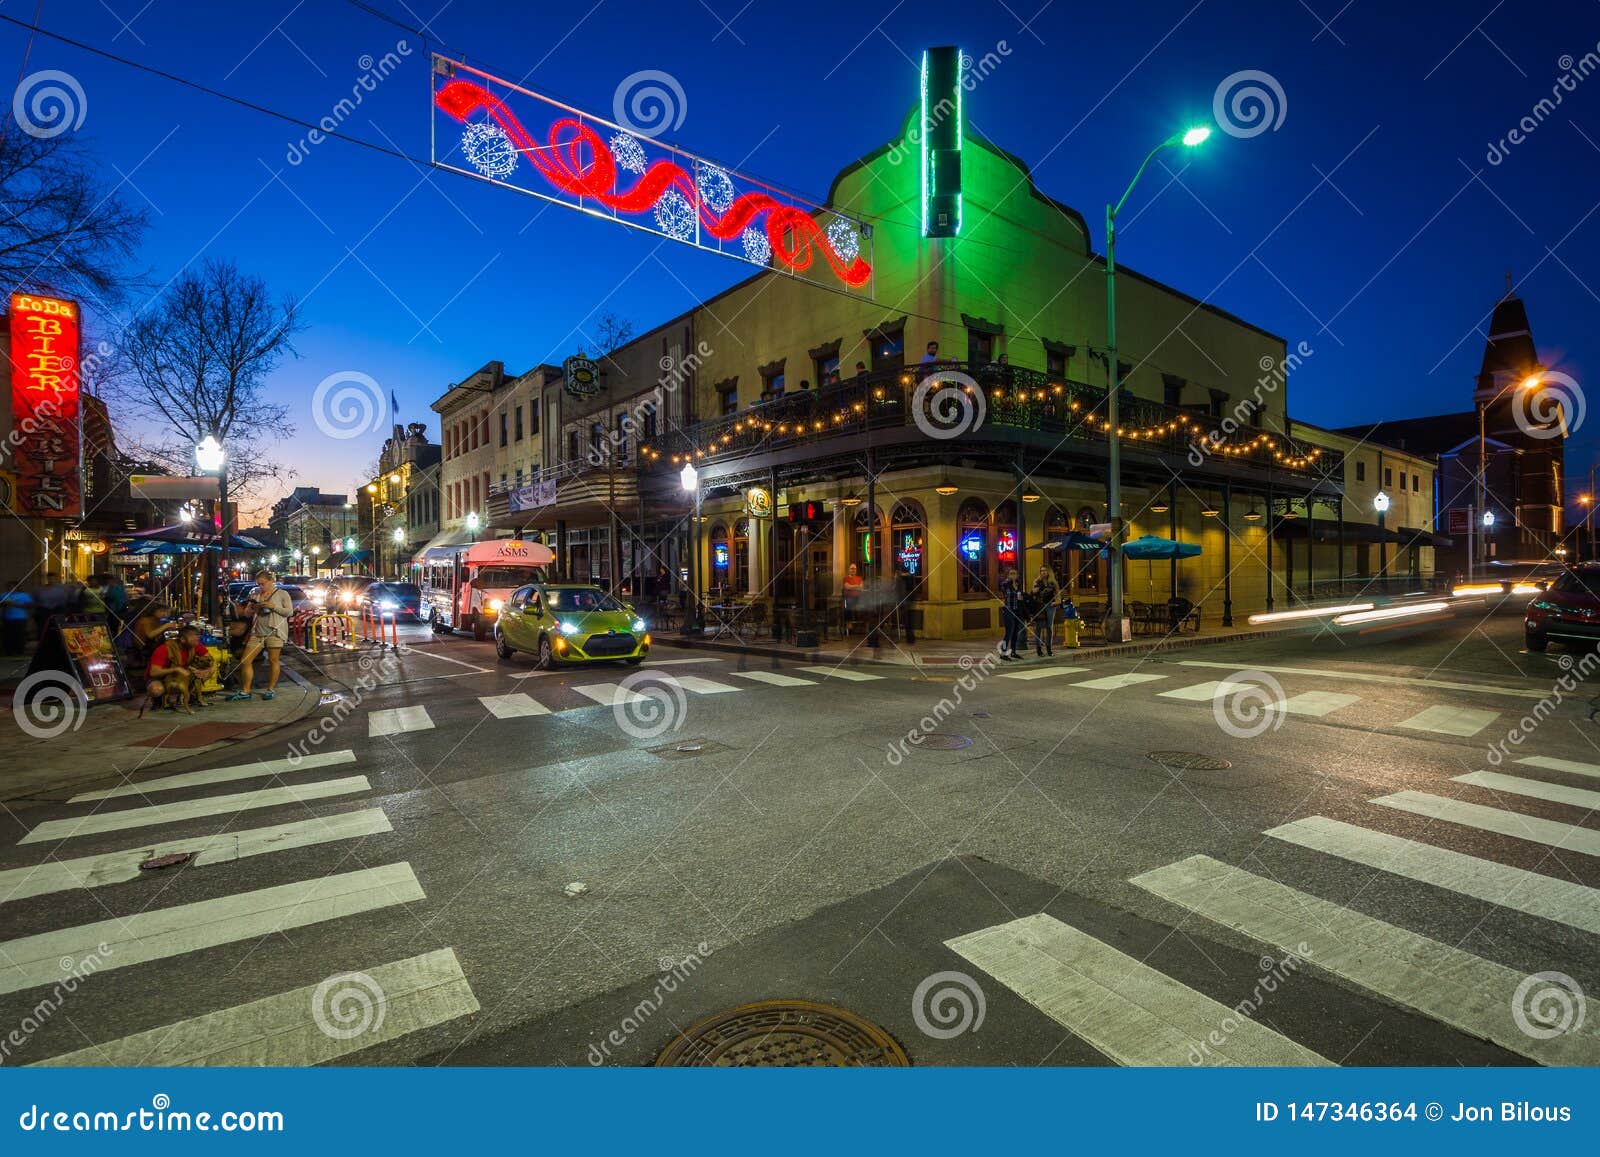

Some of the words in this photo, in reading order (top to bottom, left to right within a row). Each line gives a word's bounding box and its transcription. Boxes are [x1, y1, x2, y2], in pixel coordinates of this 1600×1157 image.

[26, 316, 66, 392] BIER
[30, 397, 65, 511] ARTEN
[497, 547, 528, 557] ASMS
